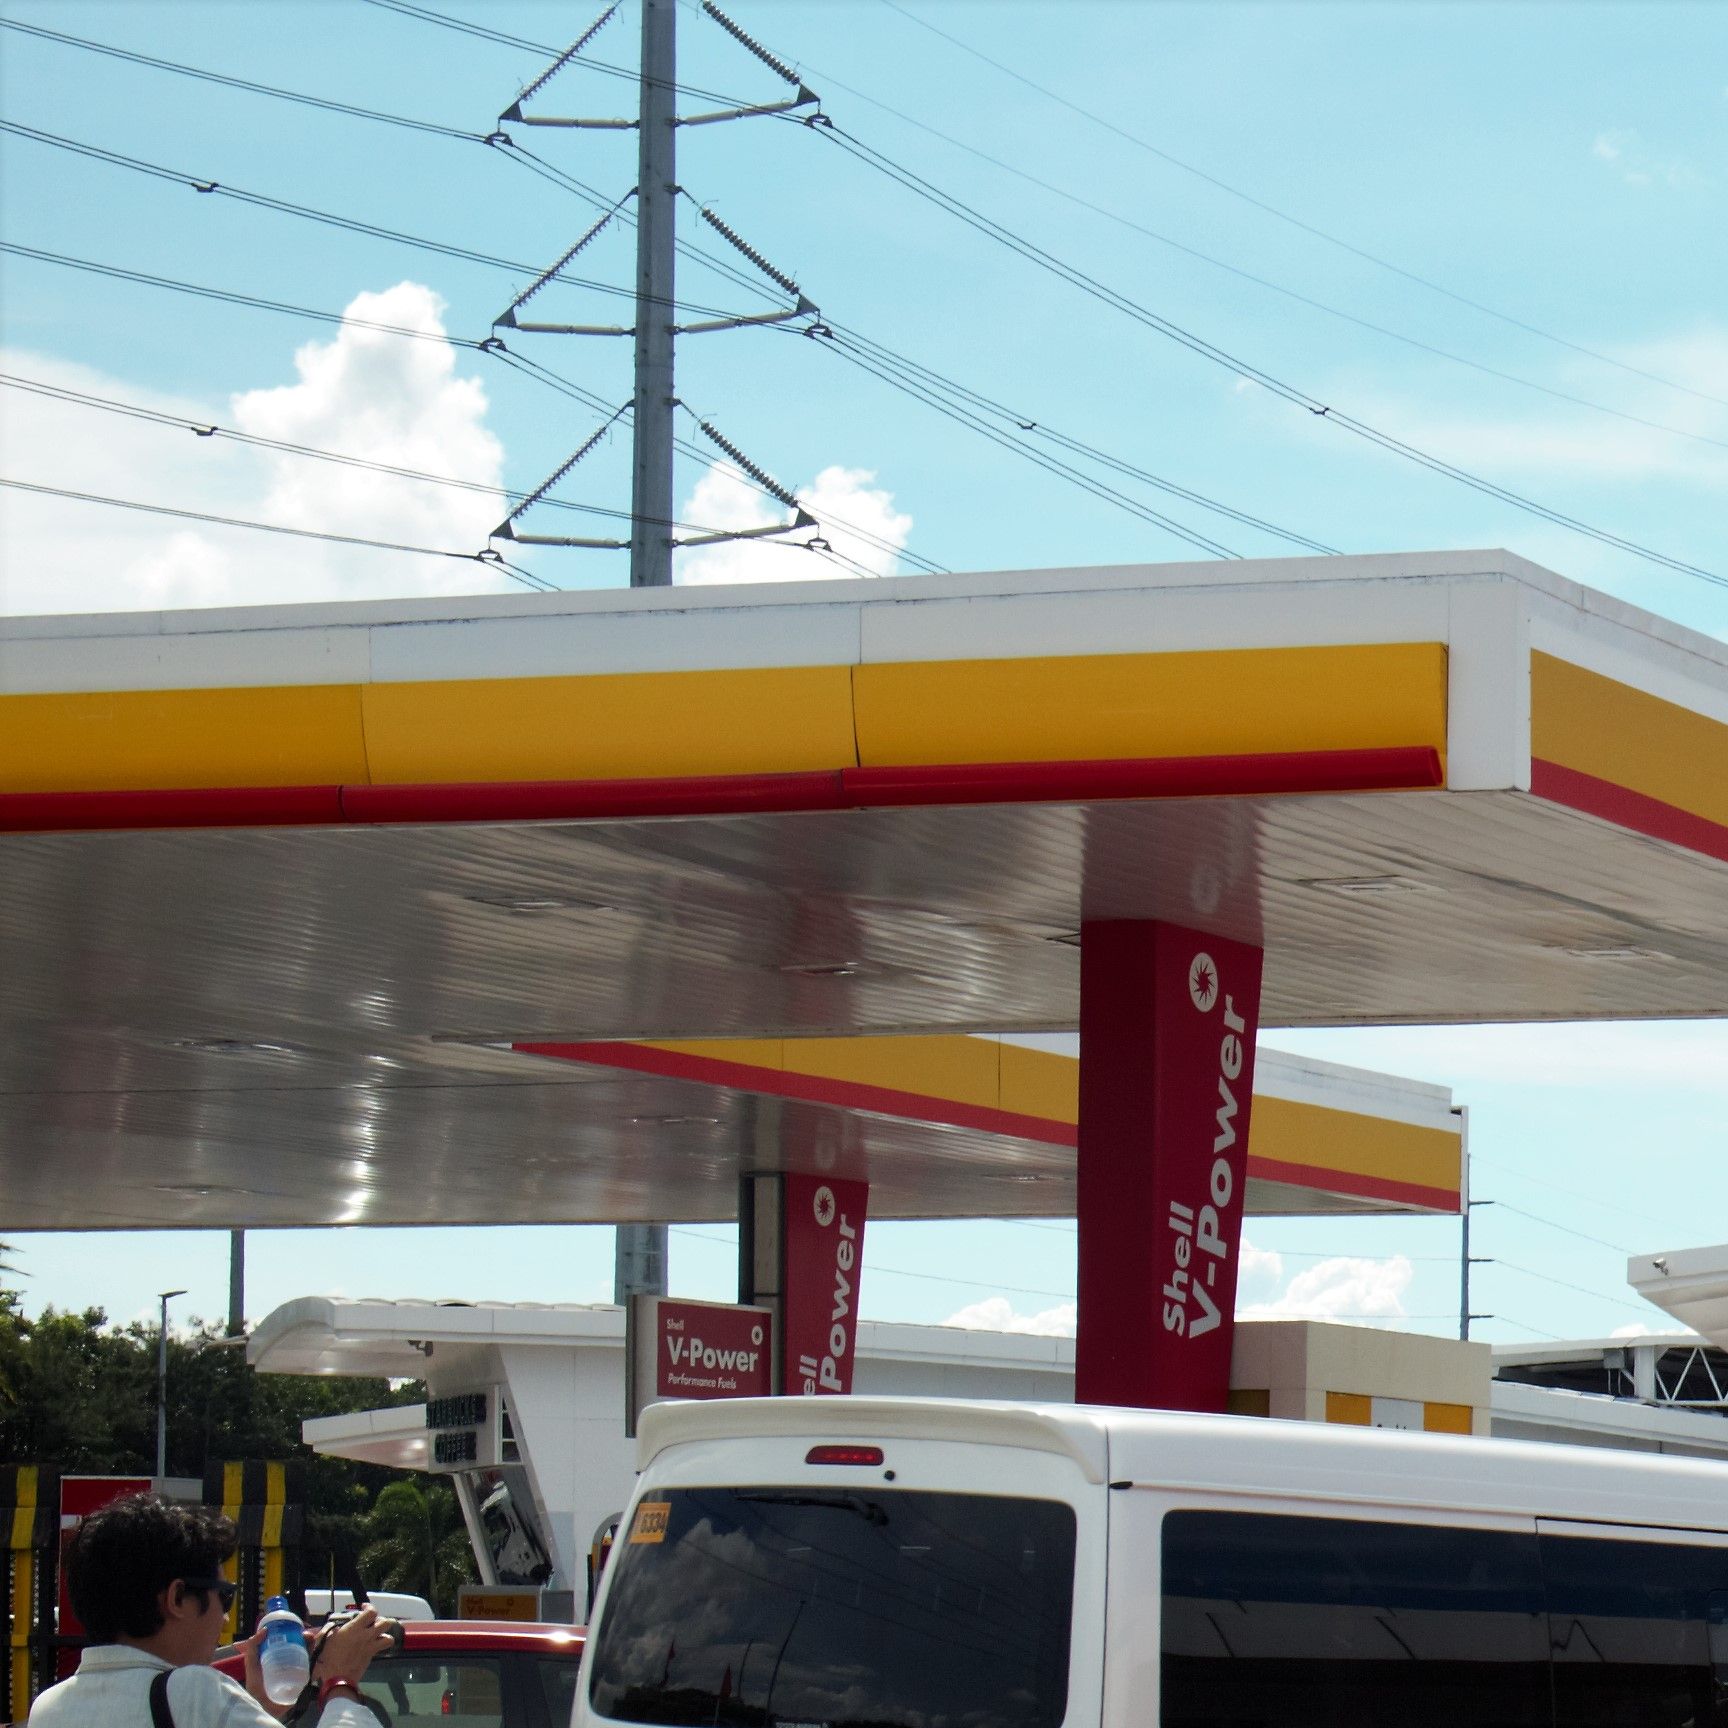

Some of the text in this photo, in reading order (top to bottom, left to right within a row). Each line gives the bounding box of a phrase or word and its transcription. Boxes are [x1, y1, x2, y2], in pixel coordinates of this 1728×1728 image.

[1188, 994, 1246, 1339] V-Power
[1162, 1200, 1194, 1337] Shell
[820, 1213, 856, 1392] Power
[666, 1318, 685, 1331] Shell
[666, 1335, 759, 1373] V-Power
[667, 1373, 737, 1390] Performance Fuels
[800, 1355, 818, 1395] ell
